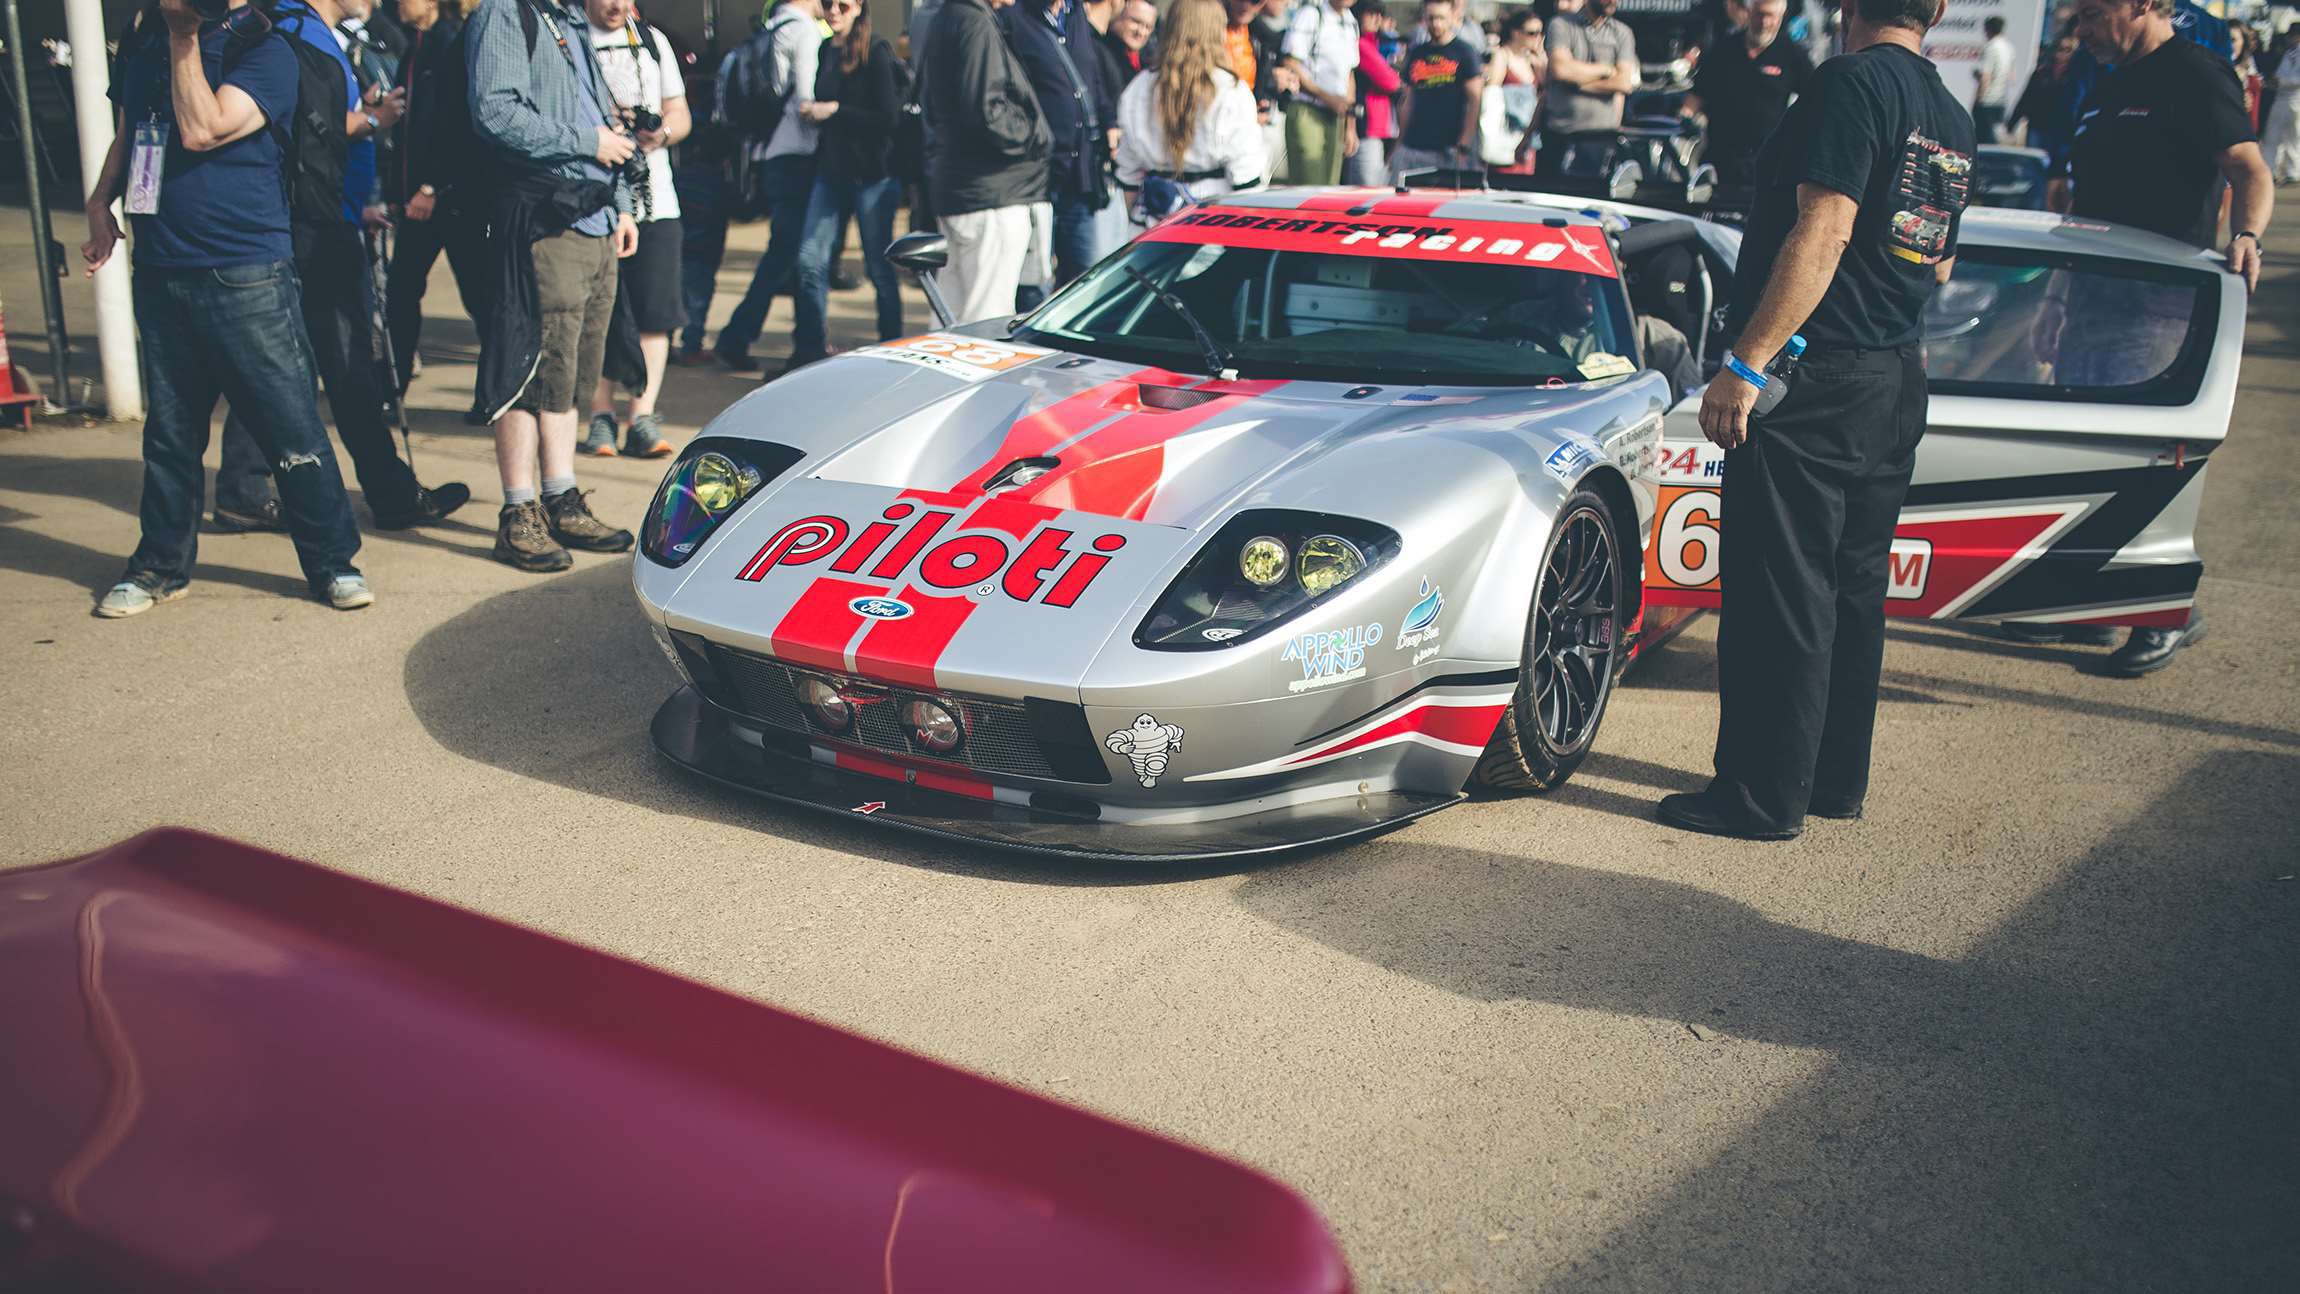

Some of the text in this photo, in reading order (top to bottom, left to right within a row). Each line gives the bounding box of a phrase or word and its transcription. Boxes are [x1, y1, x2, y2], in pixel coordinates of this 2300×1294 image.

[1172, 213, 1454, 239] ROBERTSON
[908, 335, 1018, 366] 68
[734, 502, 1128, 609] piloti
[859, 600, 901, 617] Ford
[1301, 647, 1365, 681] WIND
